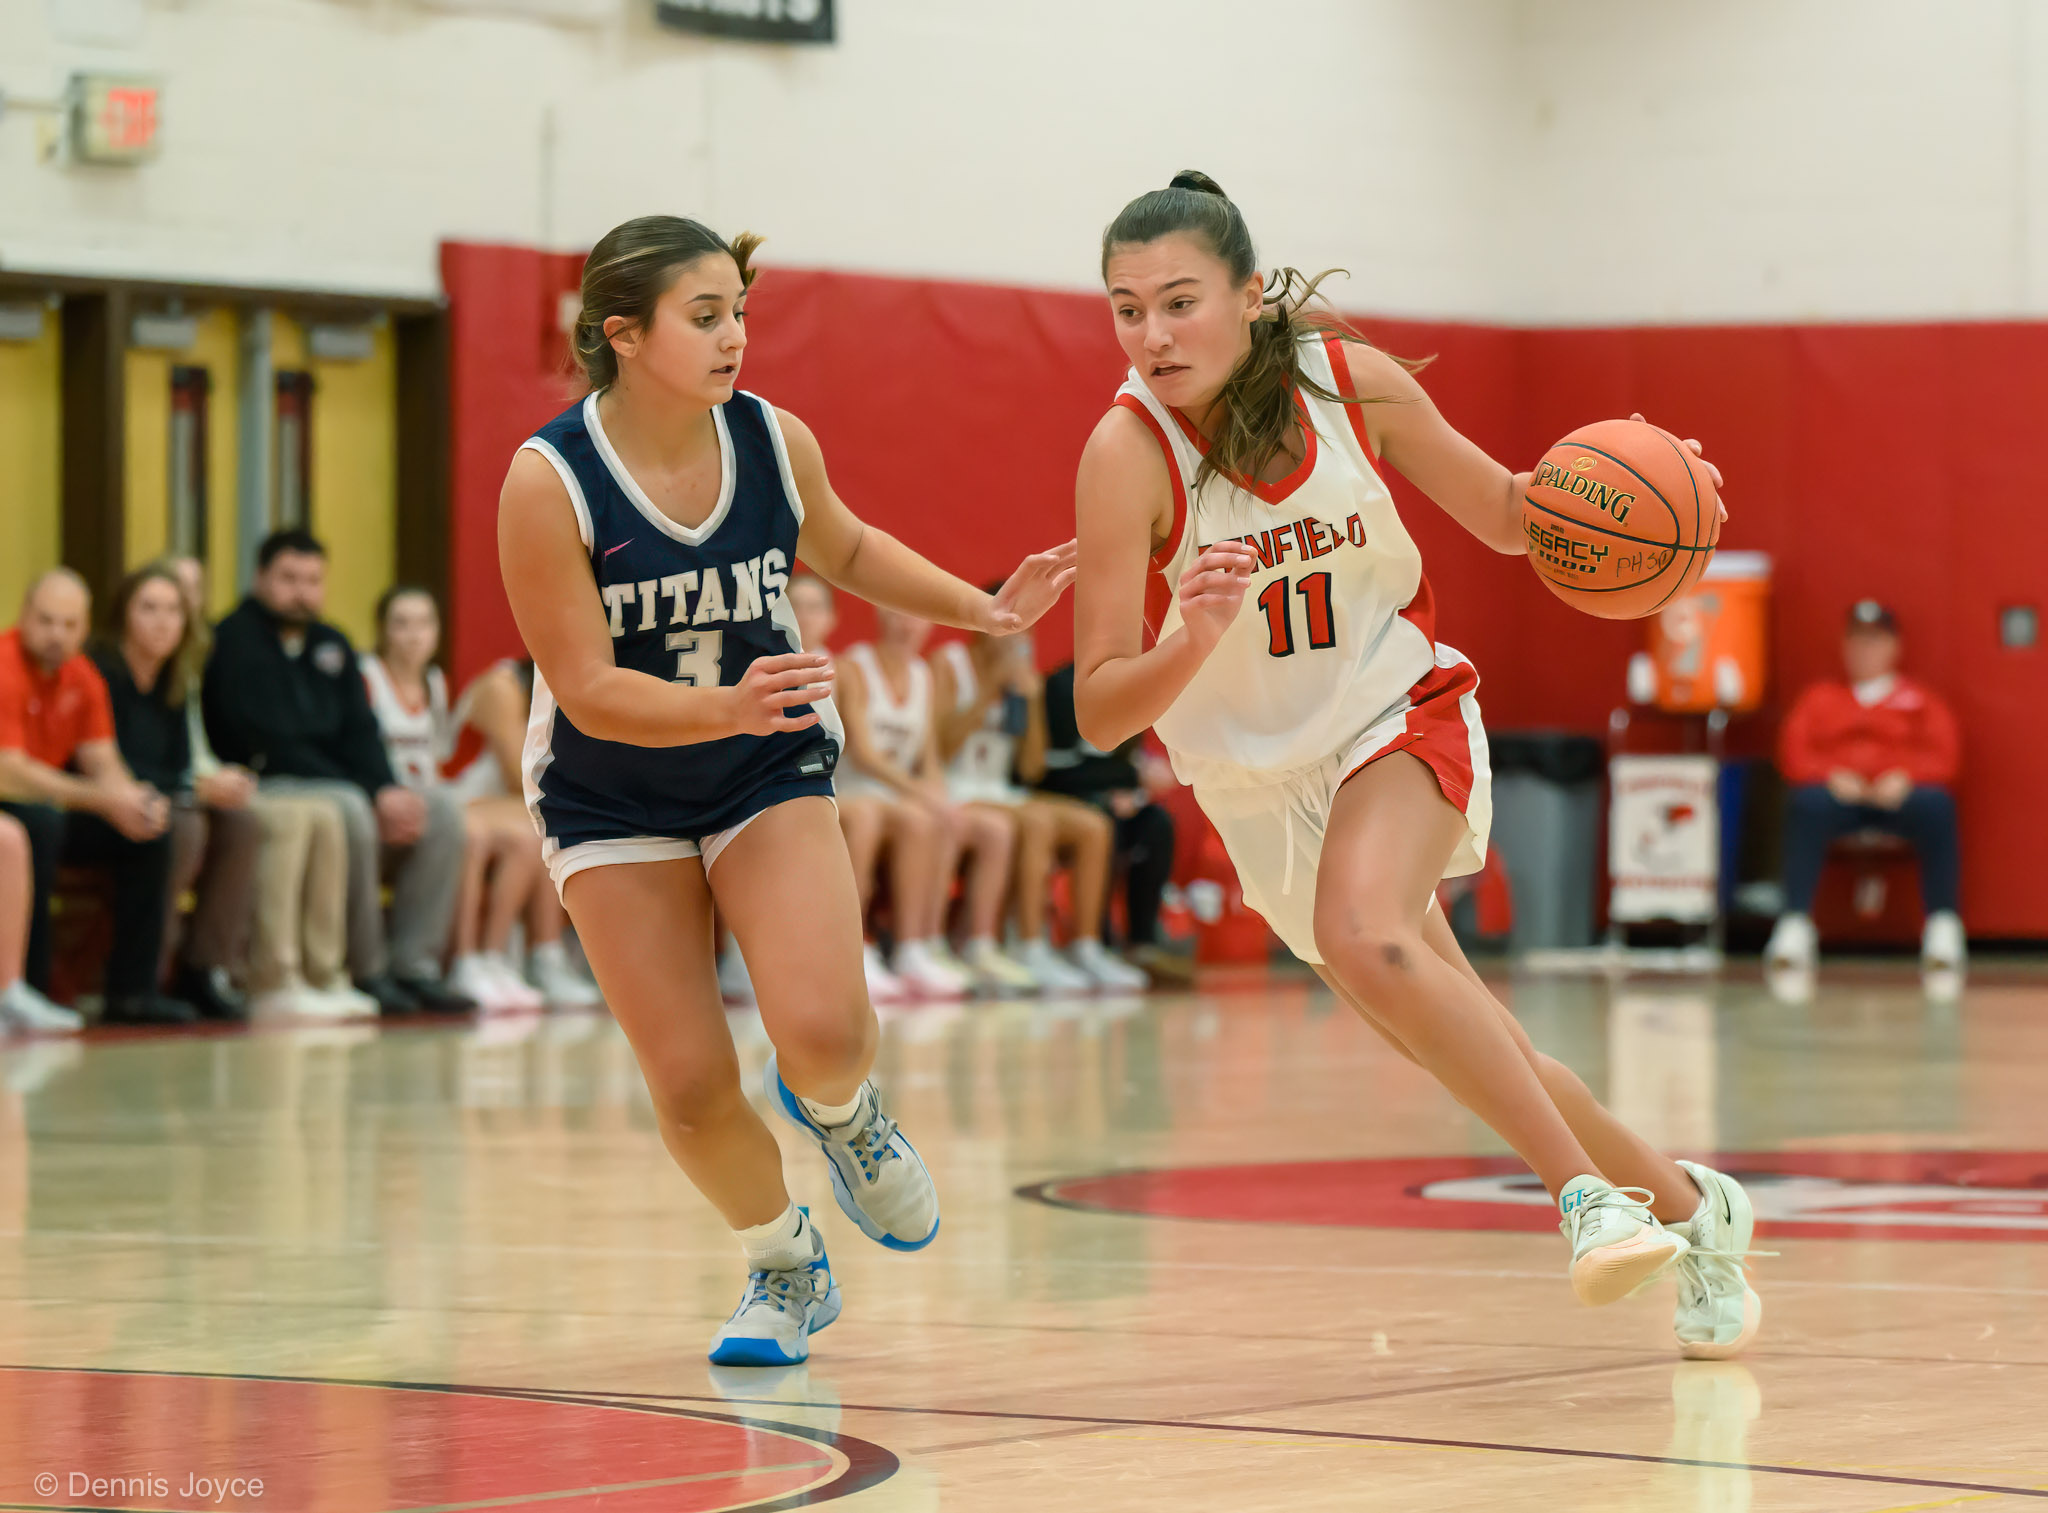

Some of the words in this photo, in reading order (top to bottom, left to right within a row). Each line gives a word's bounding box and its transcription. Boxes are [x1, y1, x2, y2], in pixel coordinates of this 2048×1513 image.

[1531, 460, 1636, 524] SPALDING
[1198, 512, 1367, 574] NFIELD
[1523, 512, 1609, 563] LEGACY
[601, 547, 789, 638] TITANS
[1257, 571, 1336, 658] 11
[665, 629, 723, 687] 3
[1562, 1188, 1585, 1213] GT
